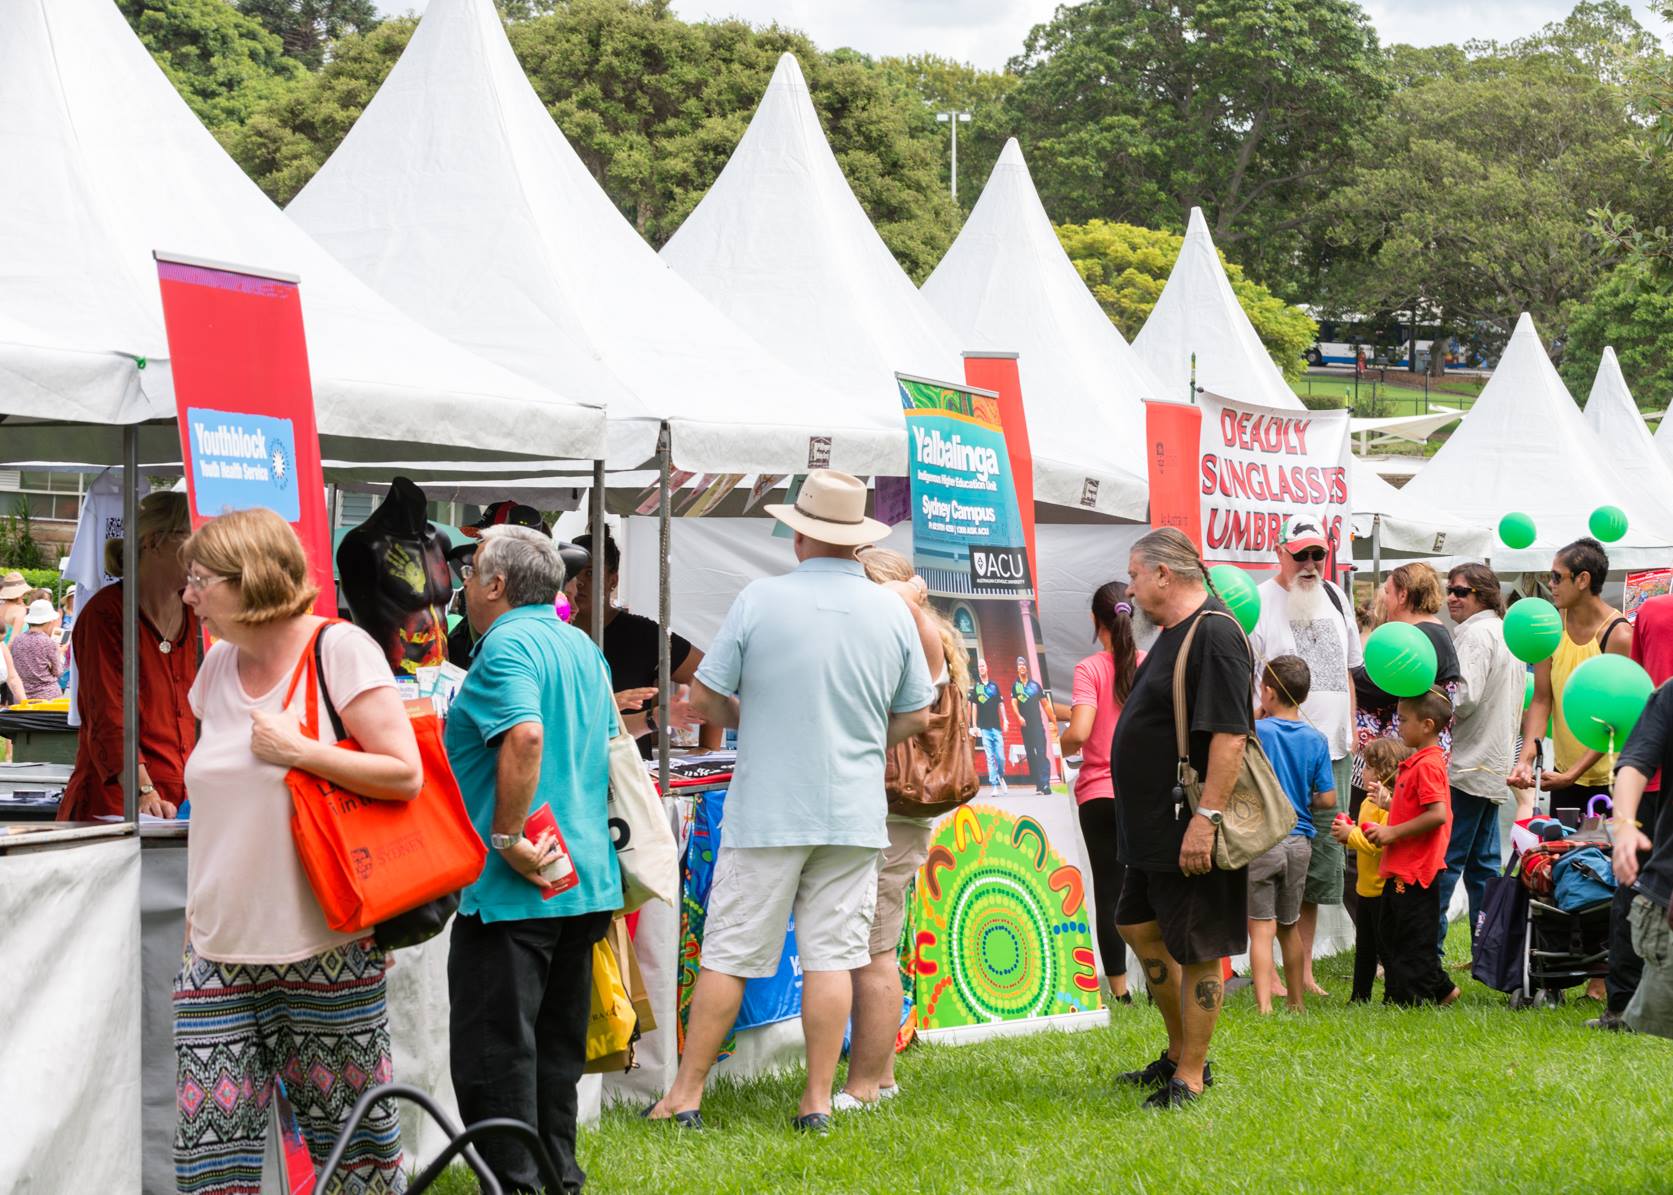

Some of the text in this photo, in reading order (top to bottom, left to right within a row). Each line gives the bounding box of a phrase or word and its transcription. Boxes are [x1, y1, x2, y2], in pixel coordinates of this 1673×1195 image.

[194, 422, 268, 460] Youthblock
[1220, 407, 1311, 455] DEADLY
[912, 425, 1000, 482] Yalbalinga
[1201, 453, 1348, 505] SUNGLASSES
[922, 494, 996, 525] Sydney Campus
[1206, 507, 1343, 551] UMBRS
[987, 552, 1024, 578] ACU
